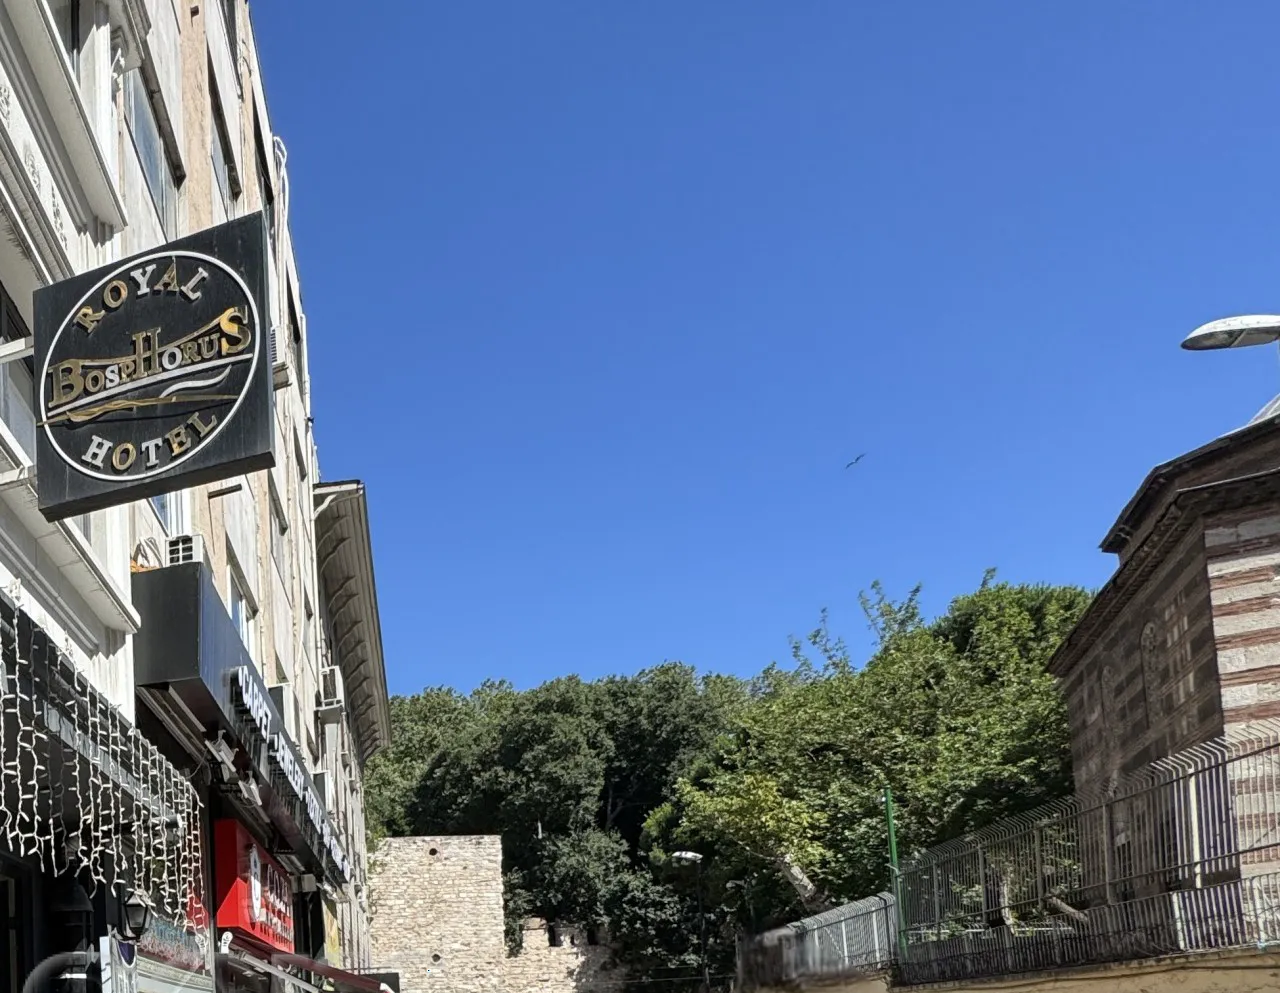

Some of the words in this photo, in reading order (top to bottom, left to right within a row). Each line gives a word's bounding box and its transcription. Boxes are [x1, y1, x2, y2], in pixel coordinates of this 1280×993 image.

[73, 256, 209, 334] ROYAL
[81, 412, 218, 471] HOTEL
[242, 664, 272, 744] CARPET
